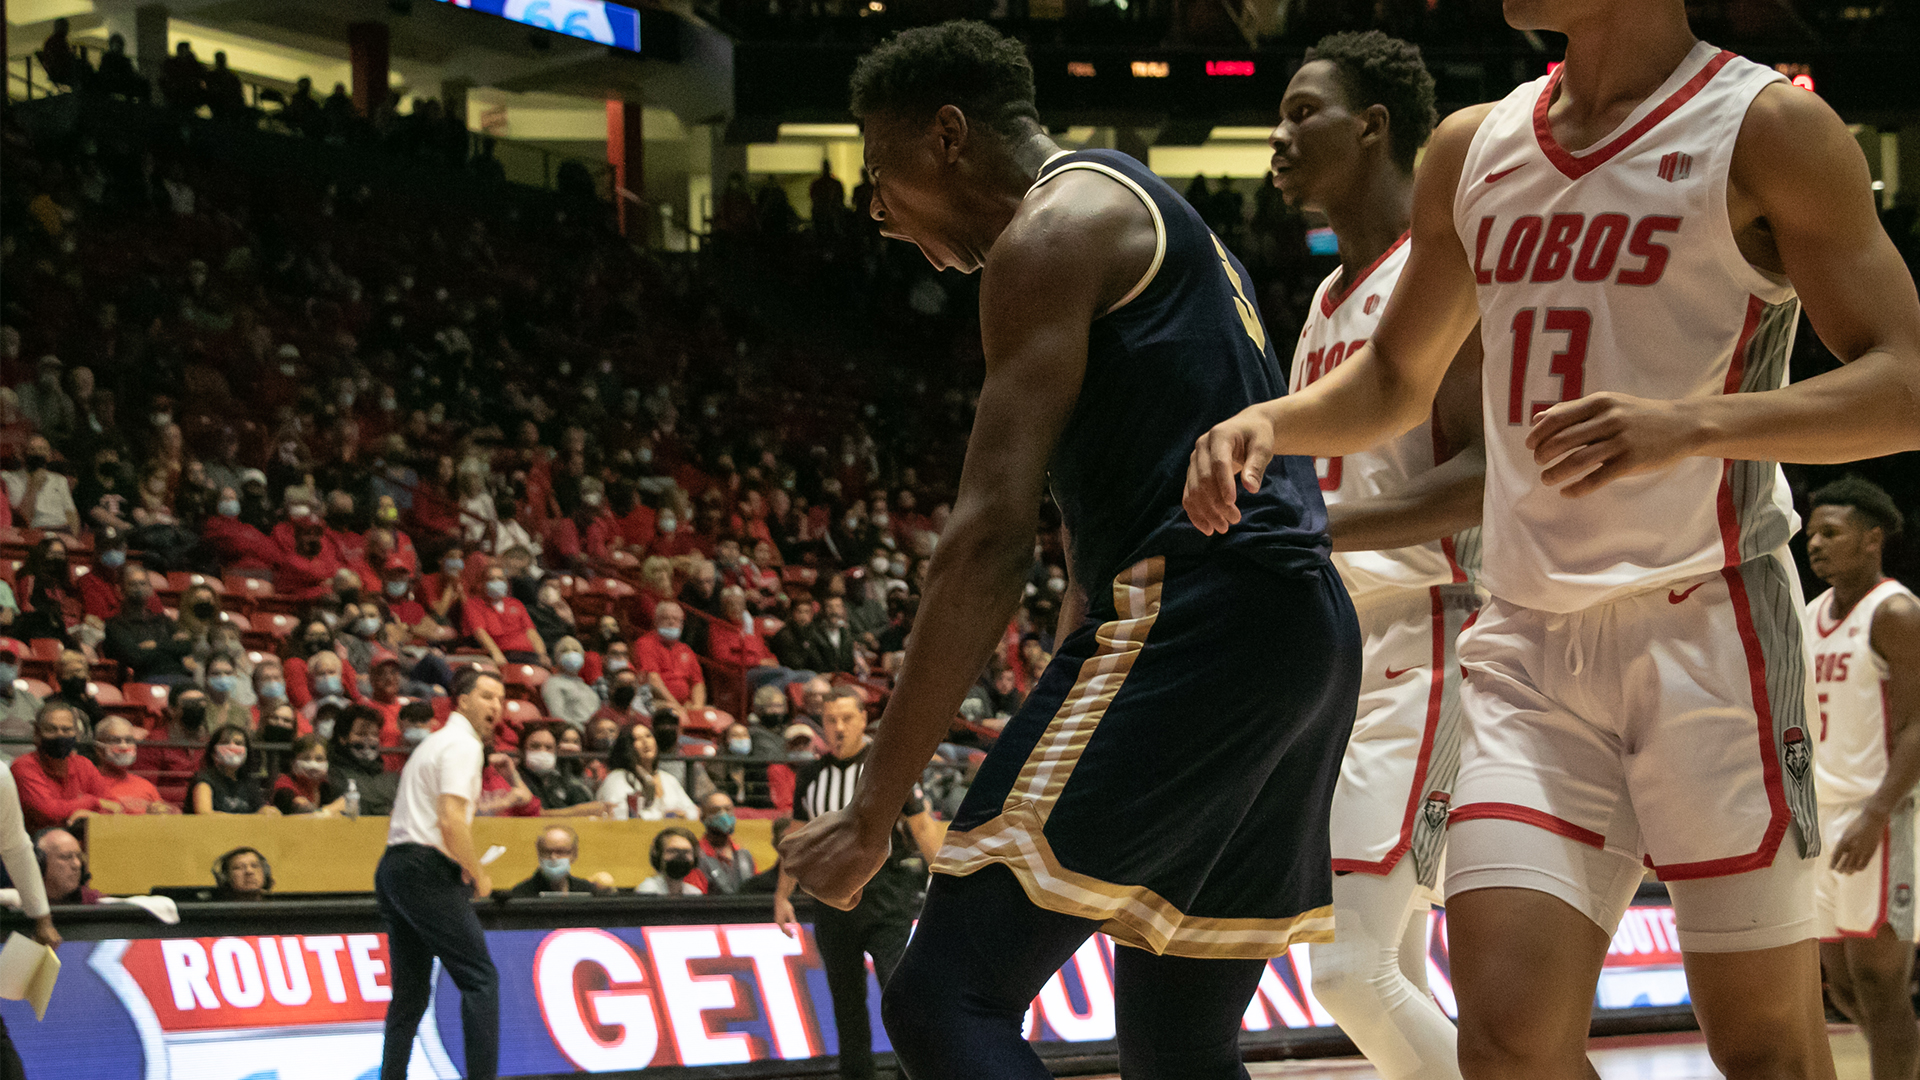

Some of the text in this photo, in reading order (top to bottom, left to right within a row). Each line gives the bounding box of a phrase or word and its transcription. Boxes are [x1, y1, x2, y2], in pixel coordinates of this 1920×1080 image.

[1474, 211, 1684, 288] LOBOS
[1507, 306, 1594, 426] 13
[161, 934, 393, 1011] ROUTE
[532, 923, 818, 1073] GET
